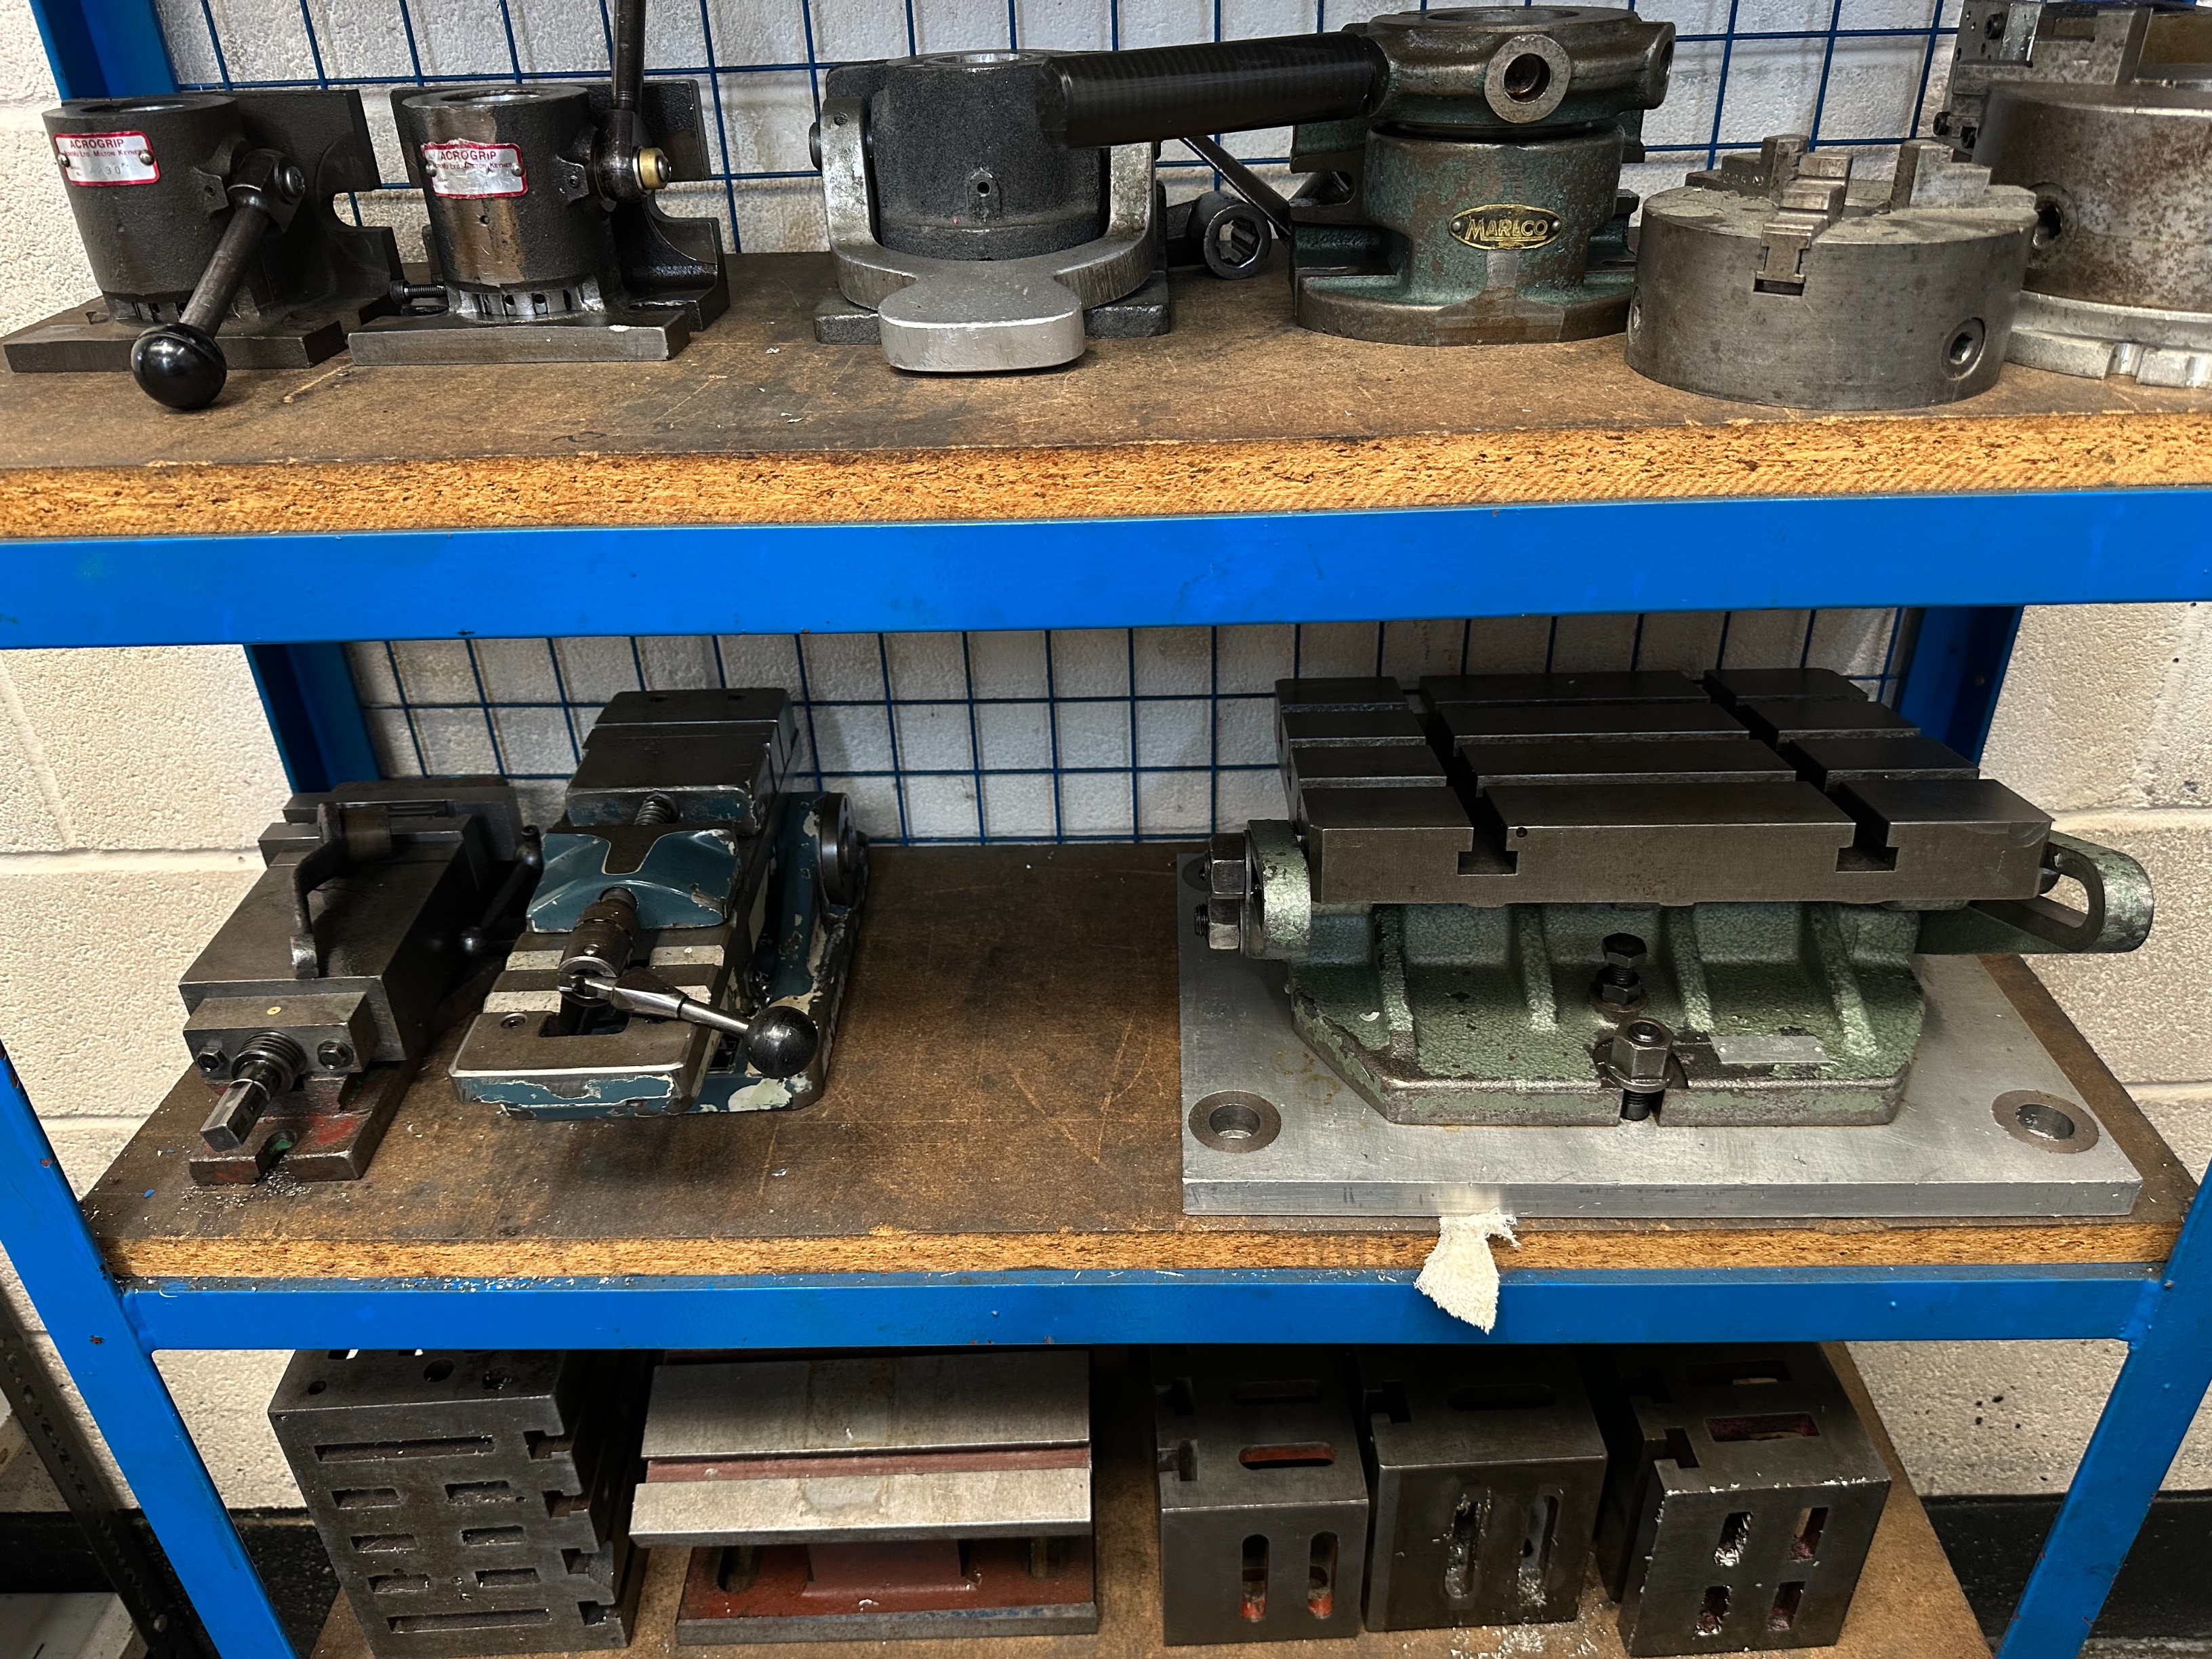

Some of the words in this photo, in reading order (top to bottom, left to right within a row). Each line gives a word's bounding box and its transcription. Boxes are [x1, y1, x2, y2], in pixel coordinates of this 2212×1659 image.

[70, 138, 124, 148] ACROGRIP
[441, 150, 497, 161] ACROGRIP
[1465, 216, 1549, 241] MARLCO
